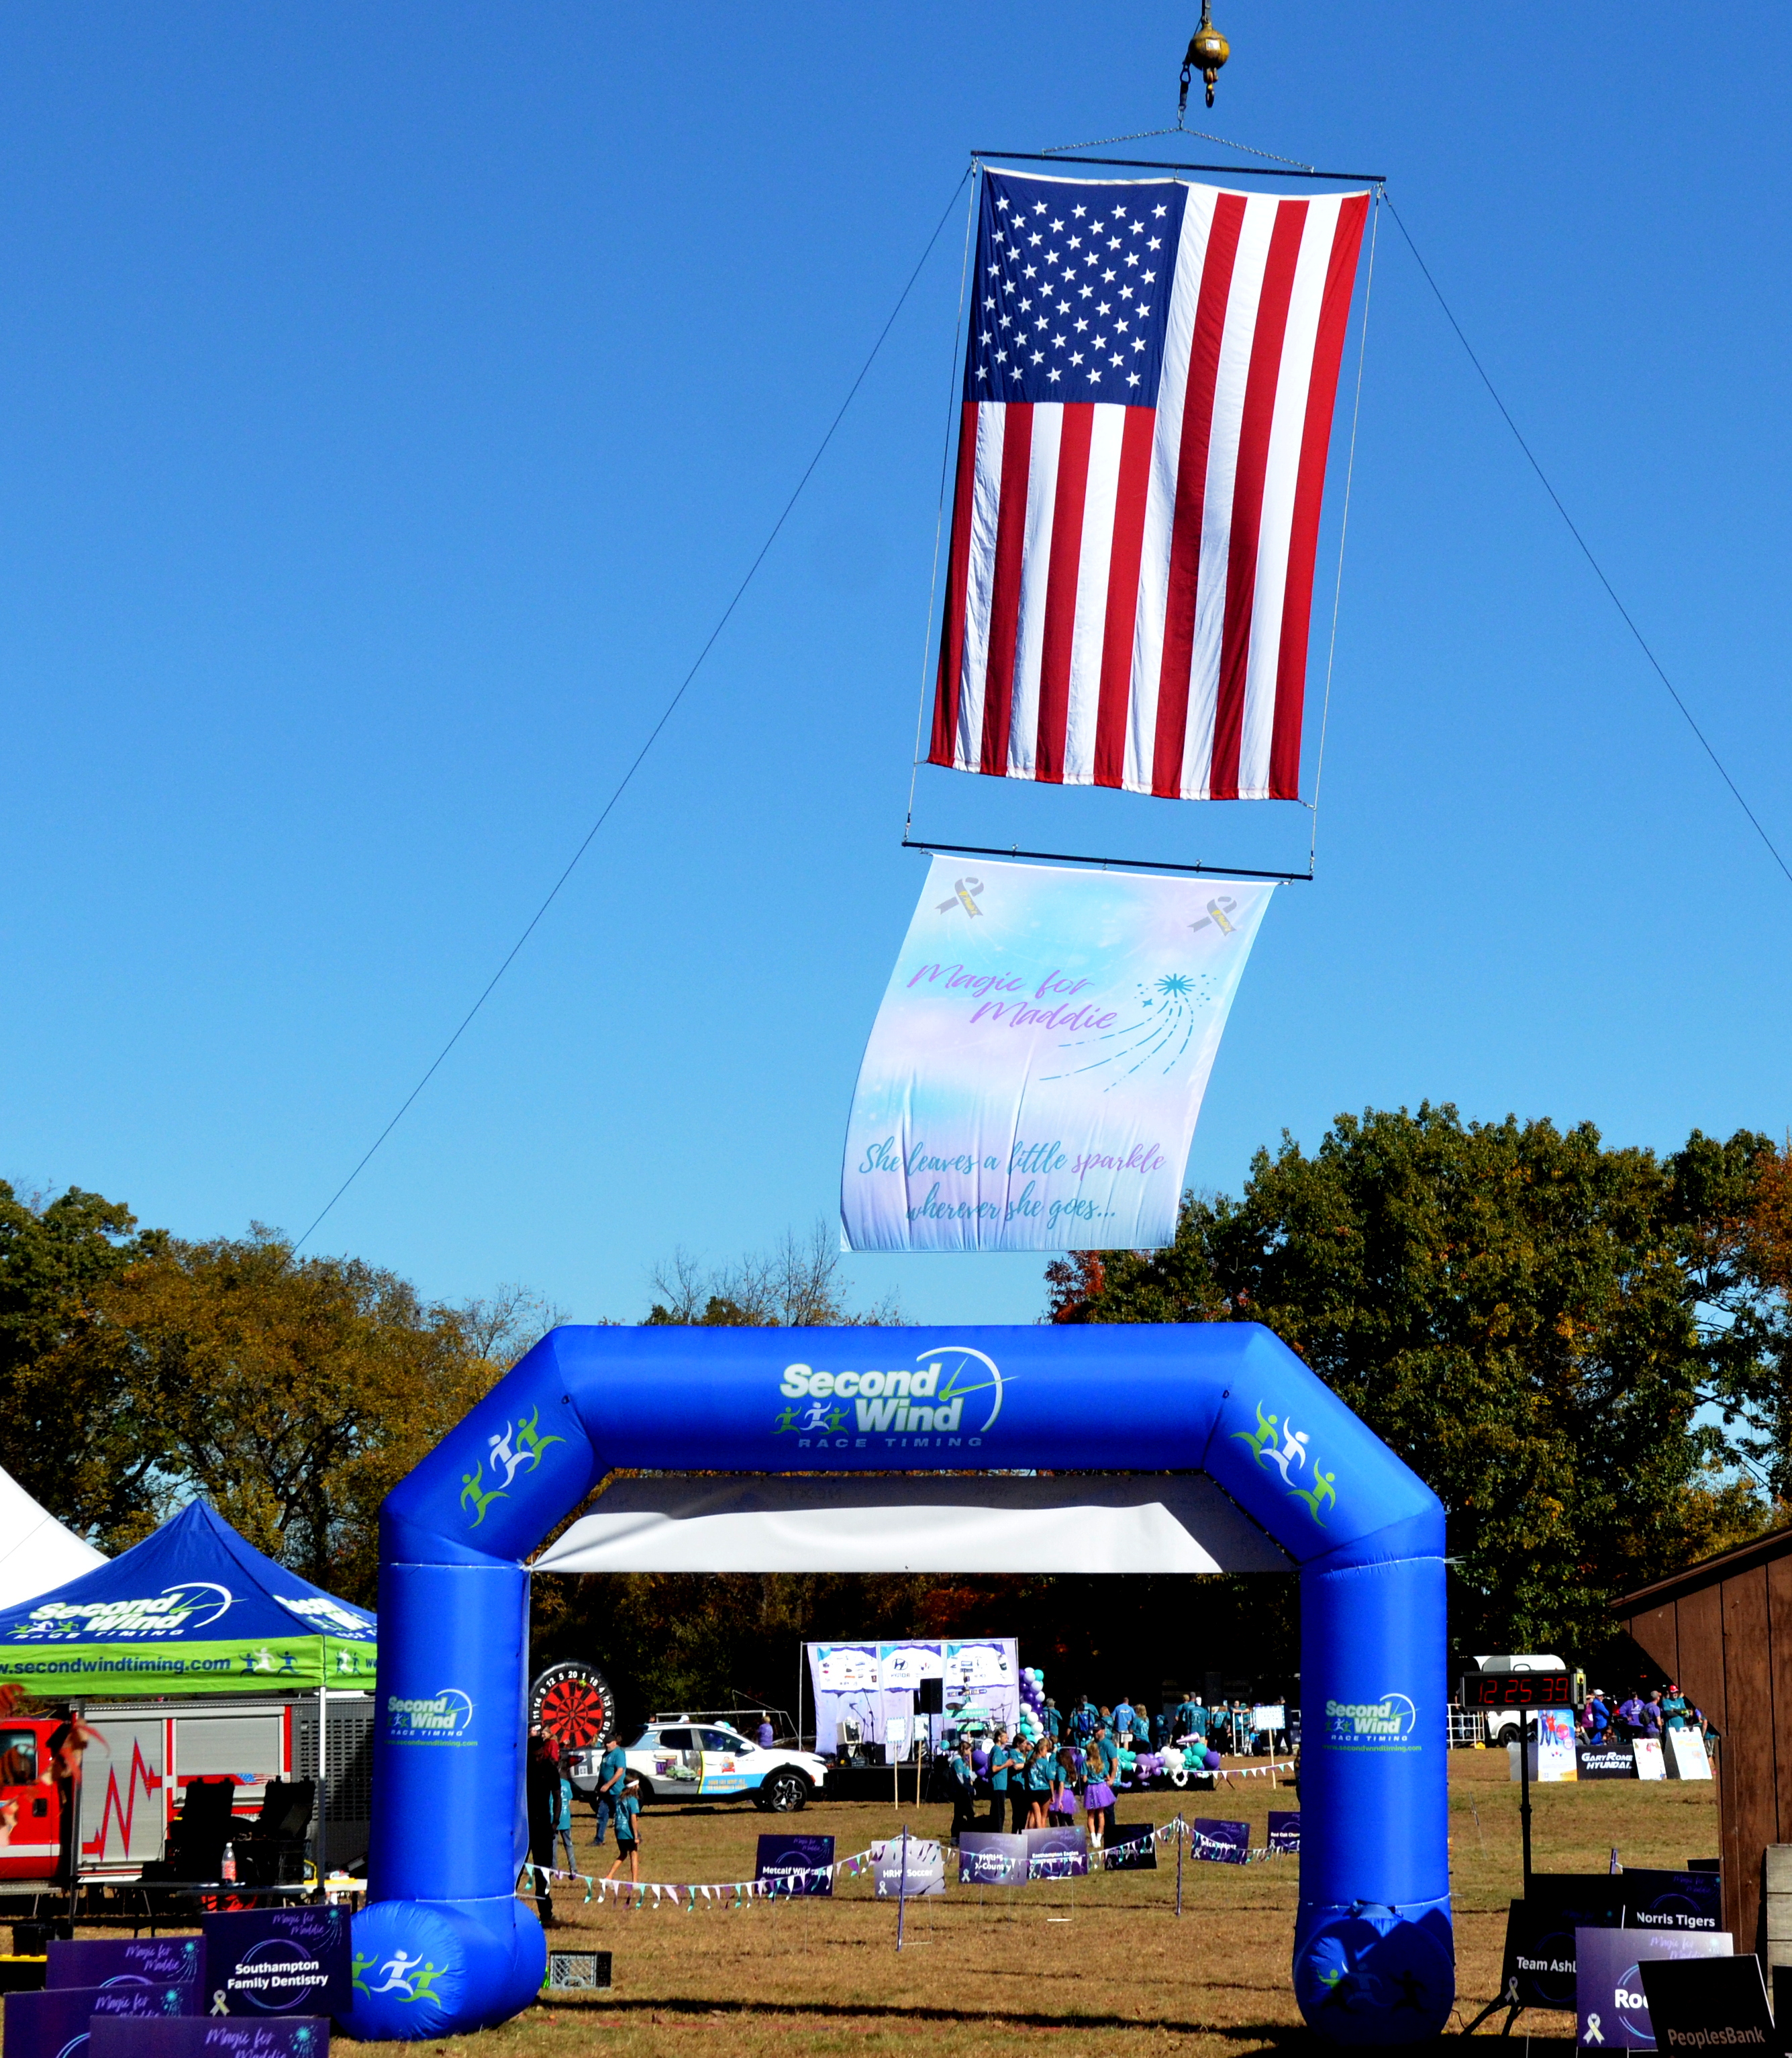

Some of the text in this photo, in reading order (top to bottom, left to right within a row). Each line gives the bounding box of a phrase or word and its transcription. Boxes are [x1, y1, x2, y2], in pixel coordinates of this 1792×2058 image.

[907, 963, 1095, 999] Magic for
[969, 1001, 1118, 1030] Maddie
[858, 1136, 1166, 1182] She leaves a little sparkle
[905, 1180, 1116, 1230] wherever she goes...
[779, 1363, 942, 1398] Second
[855, 1397, 964, 1432] Wind
[798, 1438, 983, 1448] RACE TIMING
[30, 1592, 185, 1620] Second
[83, 1610, 193, 1632] Wind
[546, 1677, 556, 1687] 12
[568, 1671, 578, 1679] 20
[589, 1677, 599, 1687] 18
[387, 1696, 448, 1713] Second
[534, 1698, 542, 1708] 14
[1325, 1700, 1393, 1719] Second
[410, 1712, 458, 1729] Wind
[532, 1710, 540, 1720] 11
[603, 1721, 611, 1731] 10
[1354, 1716, 1402, 1734] Wind
[597, 1732, 605, 1743] 15
[762, 1866, 792, 1875] Metcalf
[907, 1869, 933, 1877] Soccer
[272, 1912, 315, 1926] Magic for
[1636, 1912, 1716, 1929] Norris Tigers
[291, 1924, 324, 1936] Maddie
[126, 1943, 172, 1961] Magic for
[144, 1958, 180, 1972] Maddie
[235, 1961, 319, 1975] Southampton
[1516, 1956, 1548, 1971] Team
[227, 1975, 329, 1991] Family Dentistry
[95, 1993, 150, 2012] Magic for
[205, 2026, 275, 2050] Magic for
[1667, 2026, 1766, 2049] PeoplesBank
